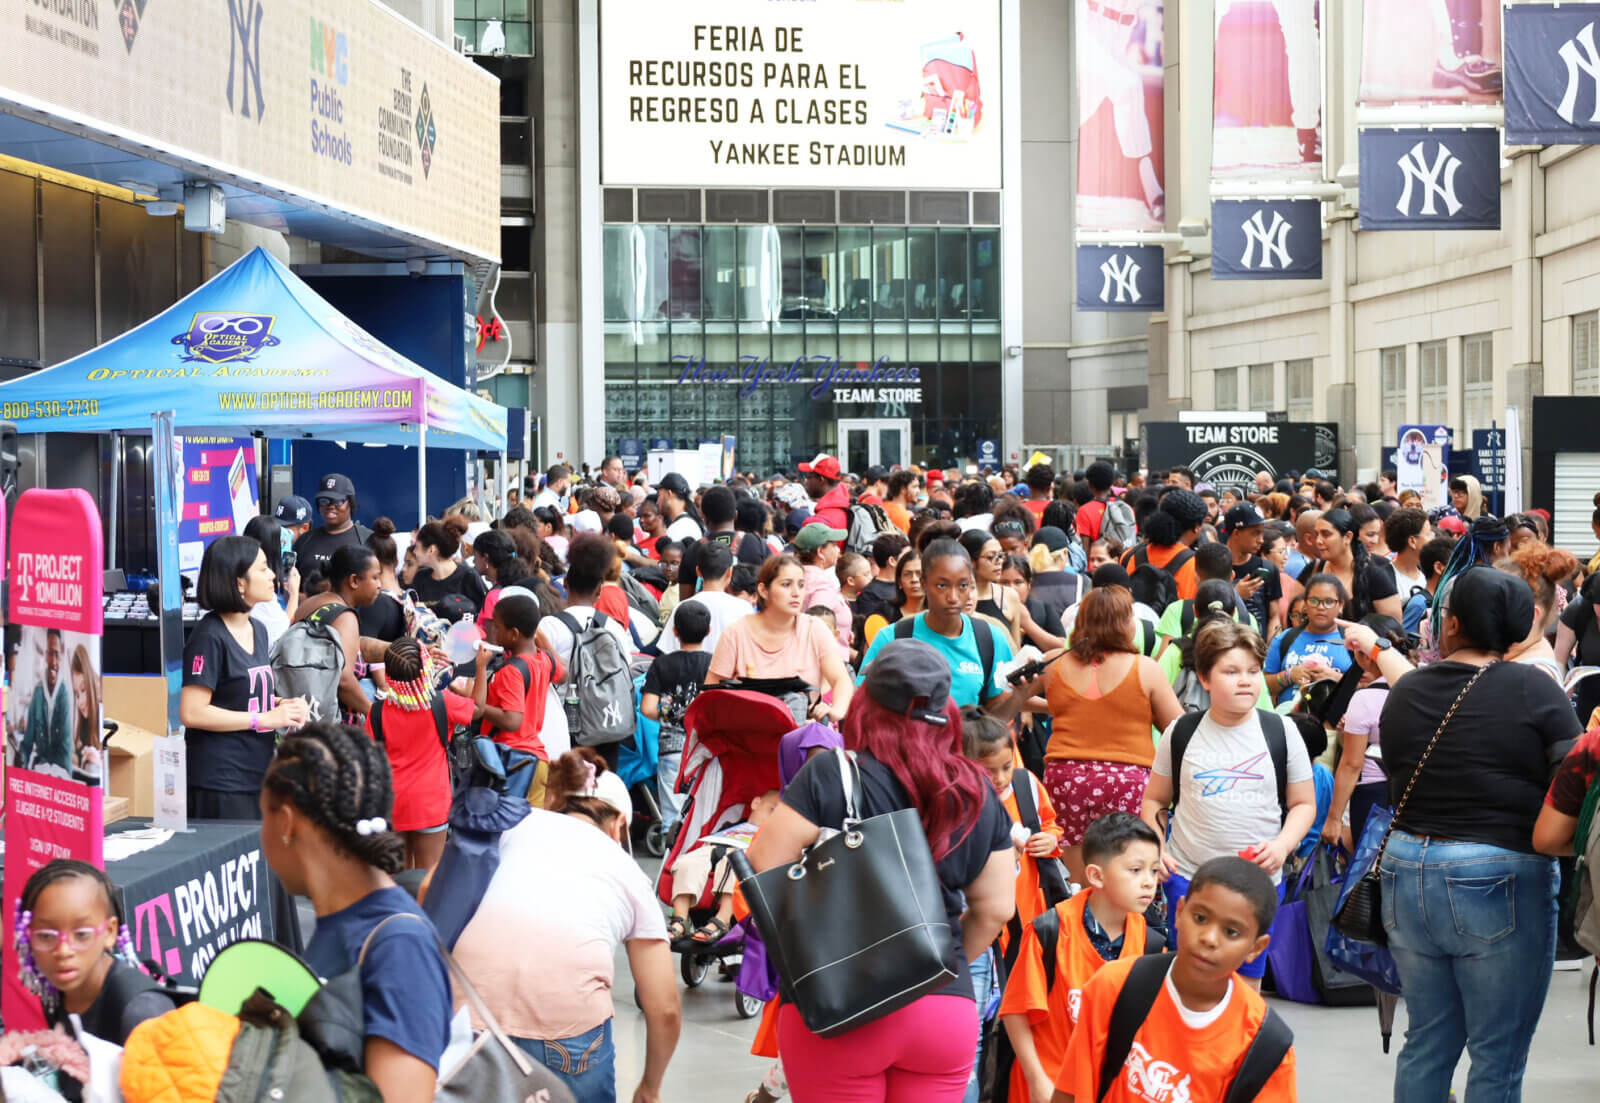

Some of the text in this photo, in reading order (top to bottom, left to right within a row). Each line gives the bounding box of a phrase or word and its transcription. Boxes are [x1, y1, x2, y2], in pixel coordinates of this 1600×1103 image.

[310, 16, 348, 87] NYC
[694, 25, 804, 52] FERIA DE
[401, 67, 412, 92] THE
[629, 60, 867, 90] RECURSOS PARA EL
[311, 78, 343, 124] Public
[629, 96, 868, 125] REGRESO A CLASES
[379, 106, 412, 144] COMMUNITY
[312, 119, 352, 166] Schools
[378, 131, 412, 168] FOUNDATION
[1396, 141, 1463, 217] NY
[1240, 209, 1293, 270] NY
[1100, 253, 1141, 304] NY
[87, 366, 334, 380] OPTICAL ACADEMY
[672, 354, 921, 398] New York Yankees
[218, 390, 413, 410] WWW.OPTICAL-ACADEMY.COM
[833, 388, 922, 404] TEAM STORE
[1186, 426, 1279, 443] TEAM STORE
[35, 553, 82, 581] PROJECT
[35, 581, 82, 608] 10MILLION
[9, 777, 90, 812] FREE INTERNET ACCESS FOR
[16, 799, 40, 818] ELIGIBLE
[54, 809, 85, 832] STUDENTS
[30, 837, 71, 859] SIGN UP TODAY
[175, 849, 260, 947] PROJECT
